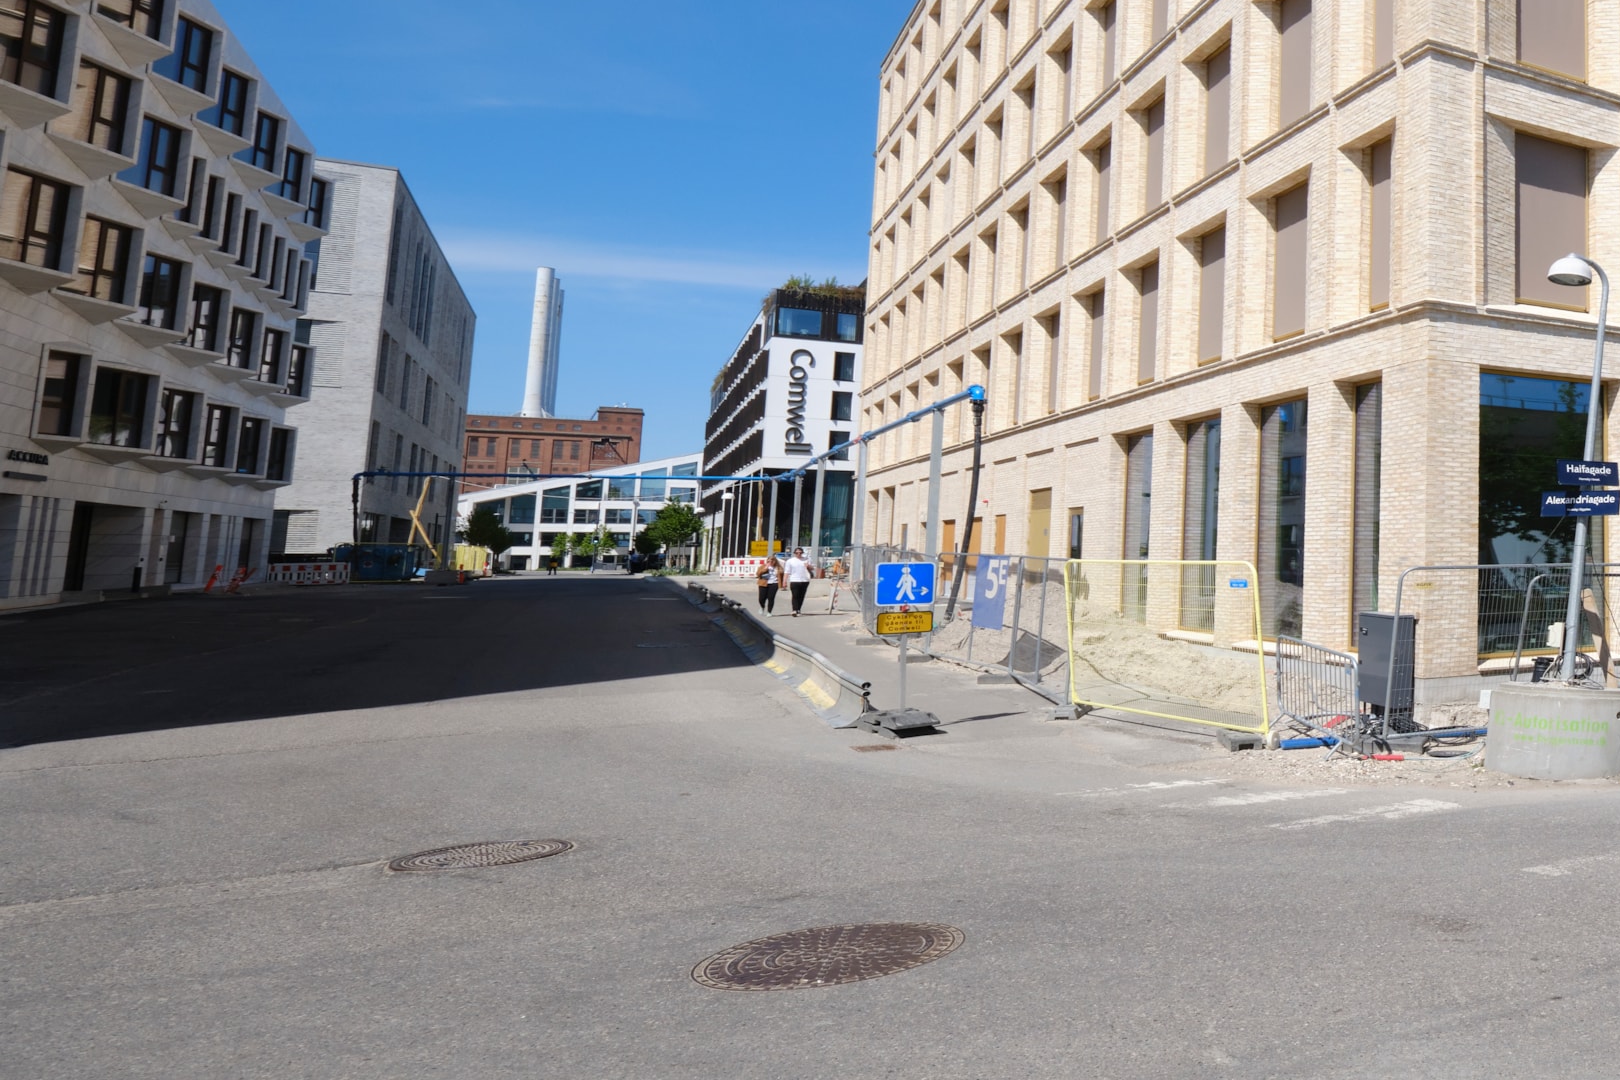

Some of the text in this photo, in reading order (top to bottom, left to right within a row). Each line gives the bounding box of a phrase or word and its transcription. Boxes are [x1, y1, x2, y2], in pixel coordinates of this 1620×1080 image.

[784, 349, 814, 454] Comwell
[7, 449, 49, 465] ACCURA
[1566, 464, 1612, 476] Haifagade
[1545, 494, 1616, 506] Alexandriagade
